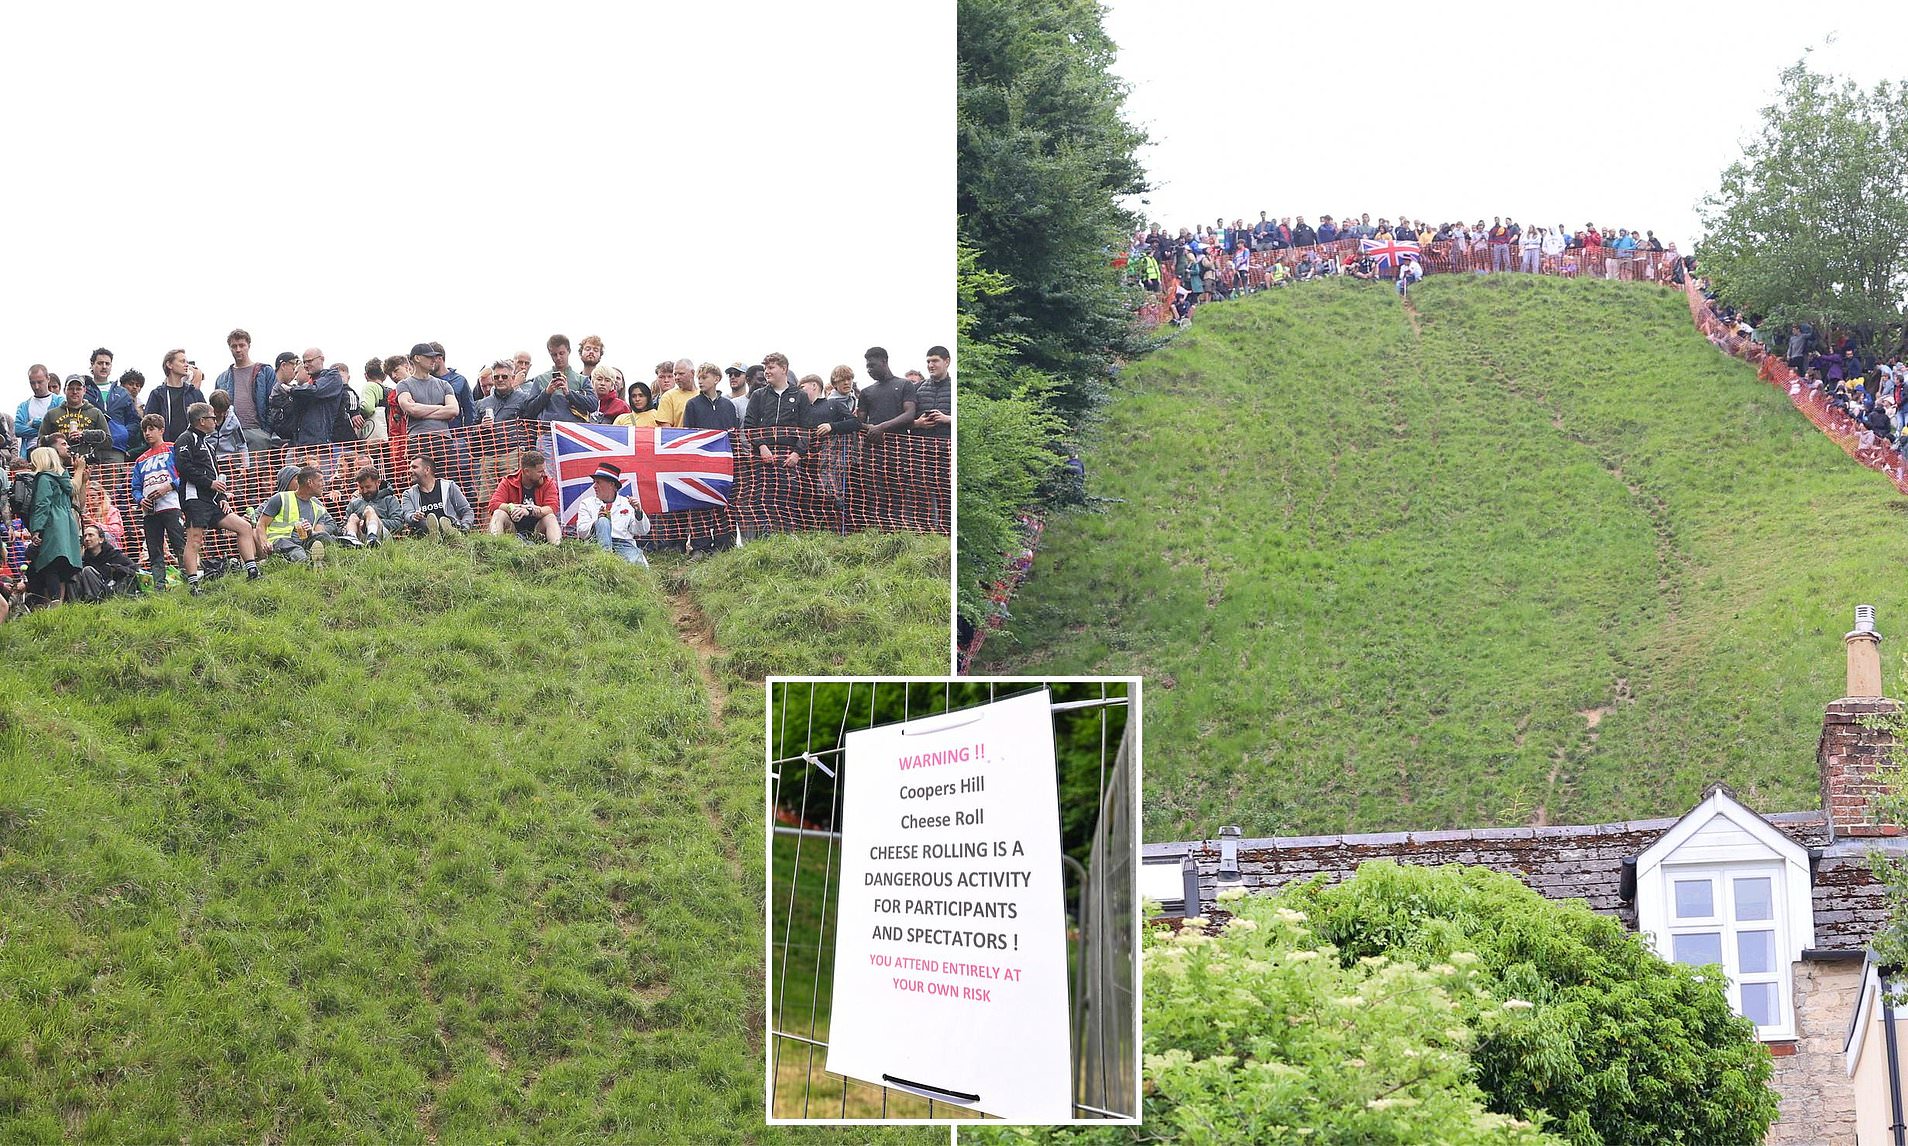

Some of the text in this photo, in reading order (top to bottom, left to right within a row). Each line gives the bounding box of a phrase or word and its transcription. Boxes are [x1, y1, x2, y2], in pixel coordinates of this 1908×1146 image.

[421, 502, 443, 512] BOSS
[899, 744, 985, 770] WARNING !!
[899, 776, 985, 801] Coopers Hill
[900, 808, 984, 830] Cheese Roll
[869, 840, 1025, 860] CHEESE ROLLING IS A
[864, 871, 1032, 888] DANGEROUS ACTIVITY
[874, 898, 1018, 919] FOR PARTICIPANTS
[872, 925, 1018, 951] AND SPECTATORS !
[869, 954, 1022, 982] YOU ATTEND ENTIRELY AT
[892, 977, 992, 1003] YOUR OWN RISK
